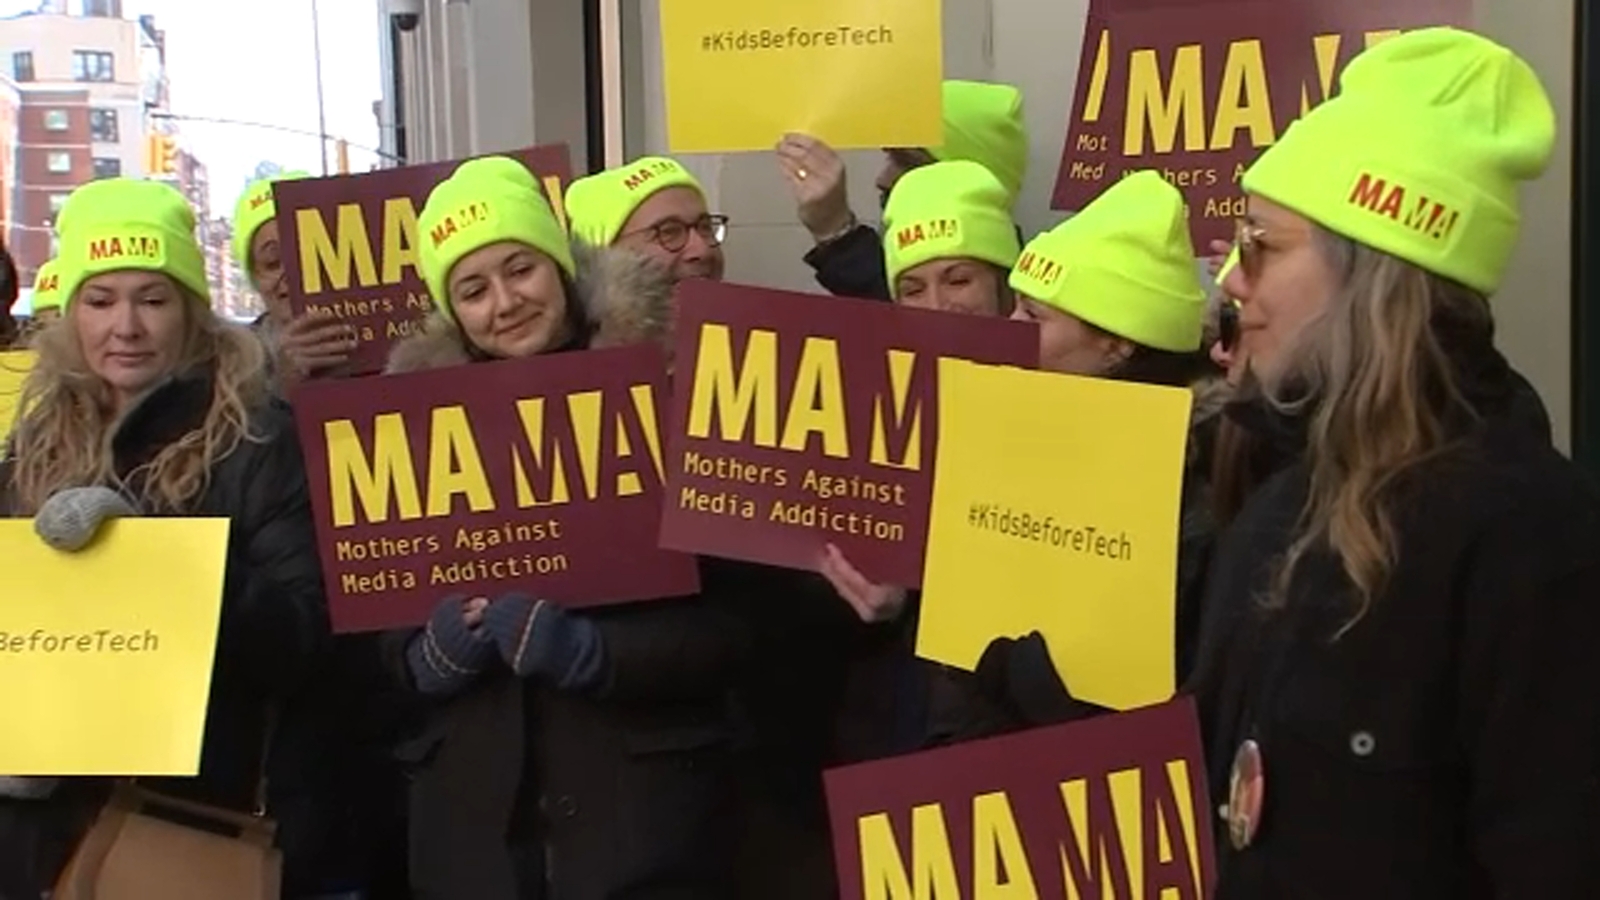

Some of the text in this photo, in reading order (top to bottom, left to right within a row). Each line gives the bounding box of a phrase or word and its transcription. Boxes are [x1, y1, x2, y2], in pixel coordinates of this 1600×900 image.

[701, 25, 894, 51] #KidsBeforeTech
[1348, 173, 1459, 239] MAMA
[684, 452, 905, 506] Mothers Against
[337, 519, 561, 561] Mothers Against
[681, 487, 904, 541] Media Addiction
[968, 502, 1132, 561] #KidsBeforeTech
[342, 551, 567, 594] Media Addiction
